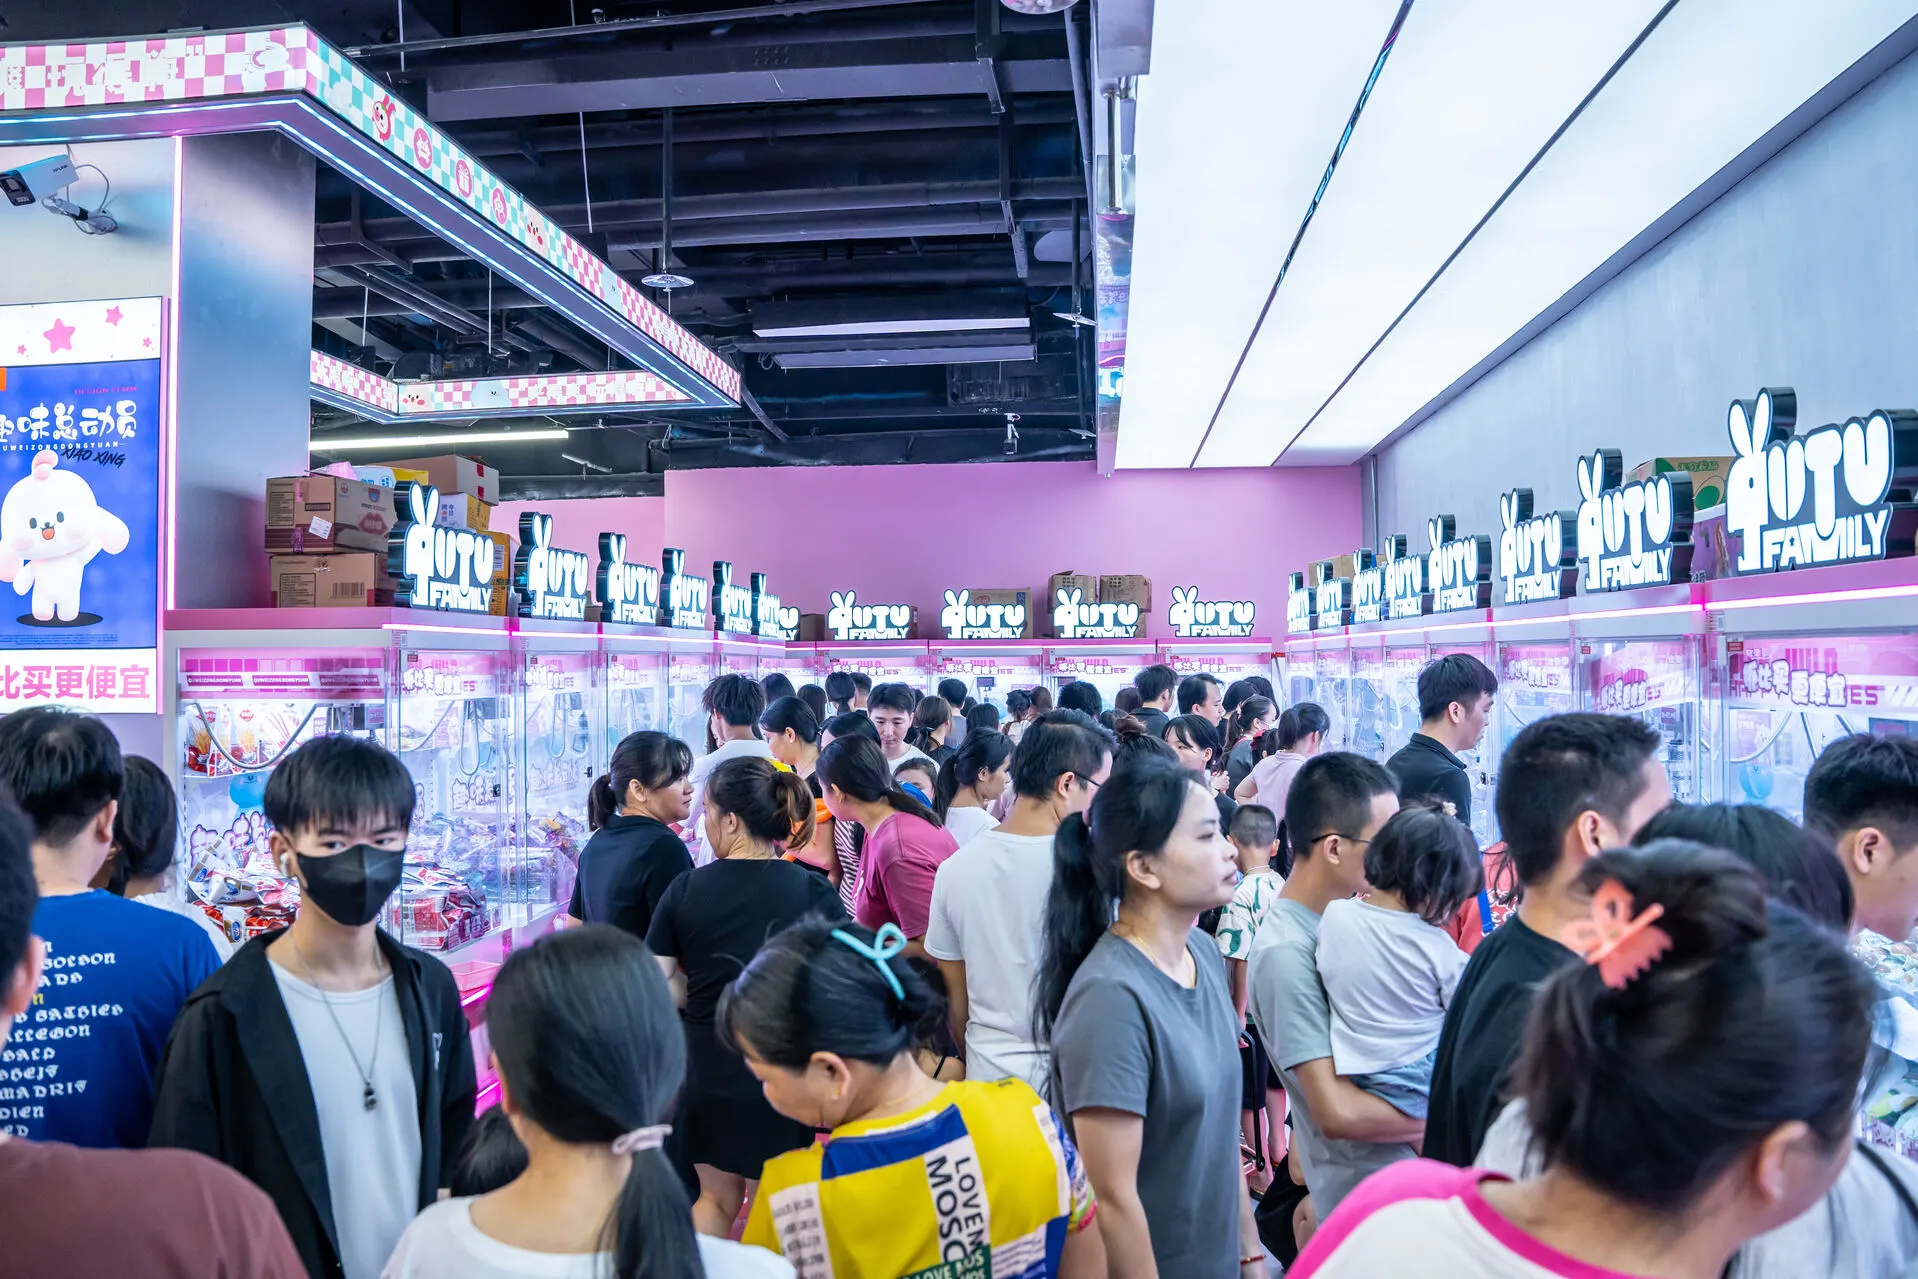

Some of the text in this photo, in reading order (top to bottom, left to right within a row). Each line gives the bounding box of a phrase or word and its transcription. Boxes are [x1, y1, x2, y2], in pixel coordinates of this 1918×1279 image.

[61, 447, 127, 468] XIAO XING
[1762, 510, 1889, 569] FAMILY
[1602, 547, 1671, 587] FAMILY
[430, 580, 492, 611] FAMILY
[1515, 571, 1561, 599] FAMILY
[544, 596, 586, 618] FAMILY
[1441, 585, 1477, 608] FAMILY
[622, 600, 657, 622] FAMILY
[847, 627, 909, 639] FAMILY
[962, 626, 1024, 639] FAMILY
[1075, 626, 1137, 638] FAMILY
[1194, 624, 1253, 636] FAMILY
[0, 664, 150, 700] 比买更便宜
